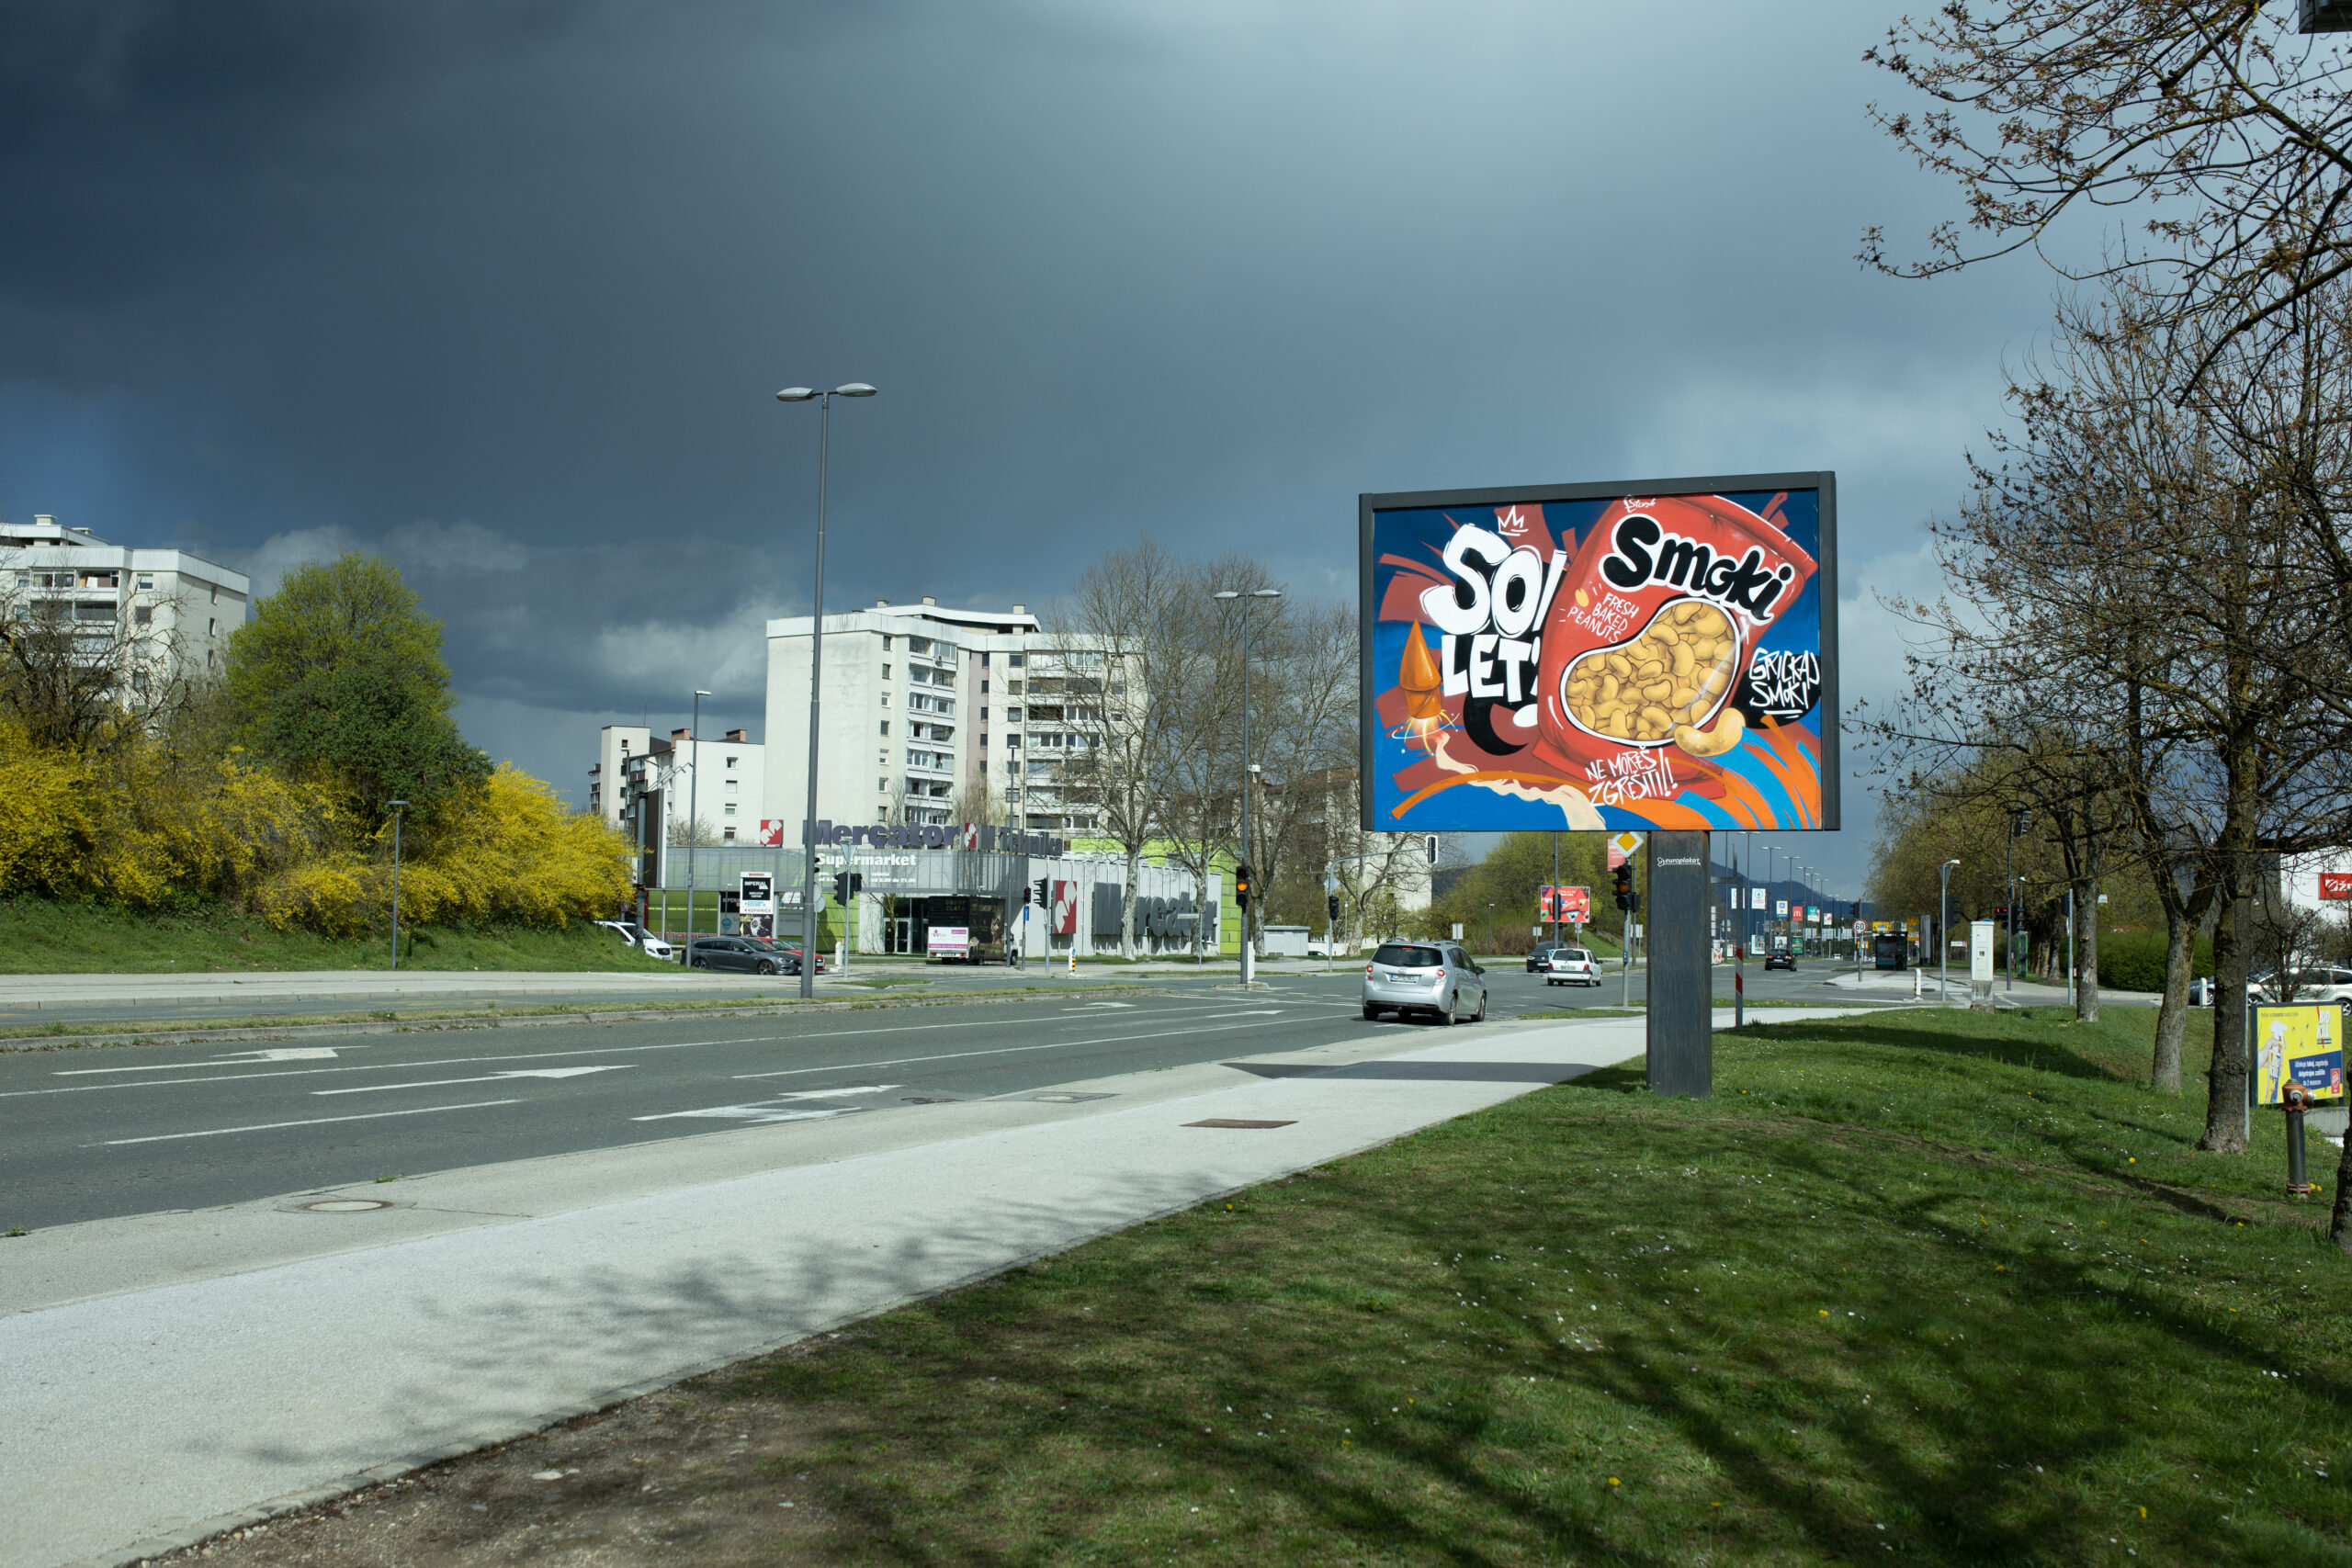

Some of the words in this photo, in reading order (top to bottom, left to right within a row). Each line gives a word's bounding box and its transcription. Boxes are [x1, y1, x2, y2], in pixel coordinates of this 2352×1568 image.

[1600, 514, 1794, 626] Smoki
[1592, 603, 1628, 631] BAKED
[1603, 592, 1639, 618] FRESH
[1567, 606, 1622, 643] PEANUTS
[1749, 680, 1809, 709] SMOKI
[1585, 759, 1607, 781] NE
[802, 819, 960, 847] Mercator
[1665, 857, 1701, 866] europlakat
[1094, 882, 1217, 937] Mrcatr
[1856, 922, 1864, 931] 60
[2320, 1010, 2331, 1024] BIO
[2317, 1024, 2330, 1038] KILL
